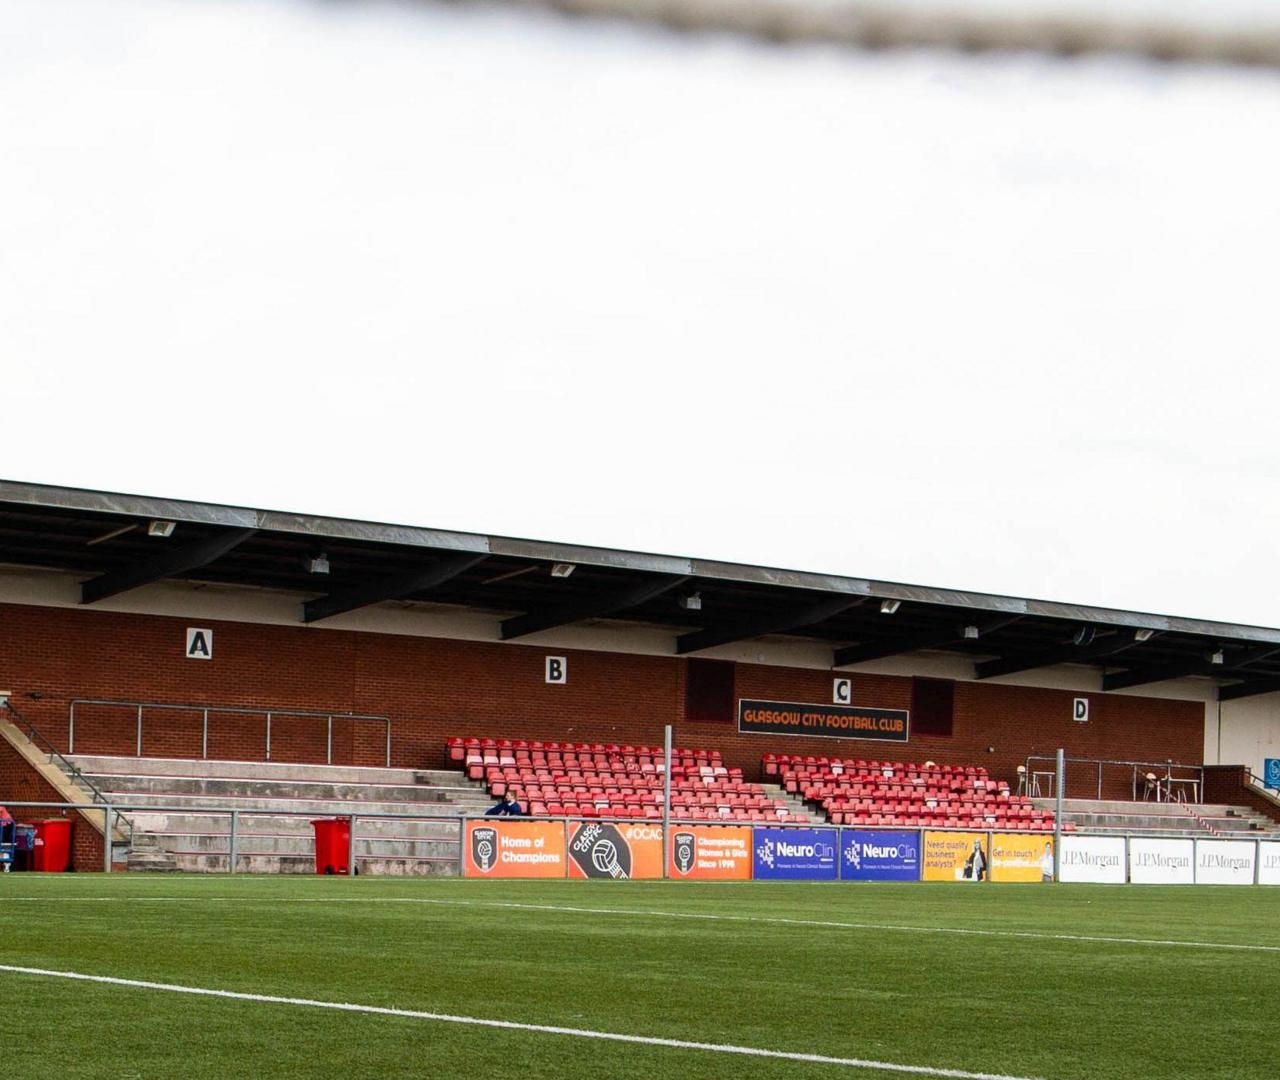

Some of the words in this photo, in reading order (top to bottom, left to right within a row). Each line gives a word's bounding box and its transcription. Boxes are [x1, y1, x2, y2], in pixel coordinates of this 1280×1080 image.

[189, 631, 209, 656] A
[549, 658, 562, 680] B
[837, 681, 848, 700] C
[1075, 700, 1086, 718] D
[744, 710, 801, 726] GLASGOW
[802, 713, 825, 727] CITY
[826, 715, 877, 731] FOOTBALL
[878, 718, 904, 732] CLUB
[501, 836, 531, 847] Home
[534, 836, 544, 847] of
[776, 842, 834, 857] NeuroClin
[863, 843, 917, 858] NeuroClin
[946, 841, 968, 850] quality
[501, 851, 560, 864] Champions
[993, 848, 1004, 857] Get
[1014, 849, 1032, 857] touch
[1062, 851, 1119, 869] J.P.Morgan
[1135, 852, 1189, 870] J.P.Morgan
[1200, 854, 1251, 872] J.P.Morgan
